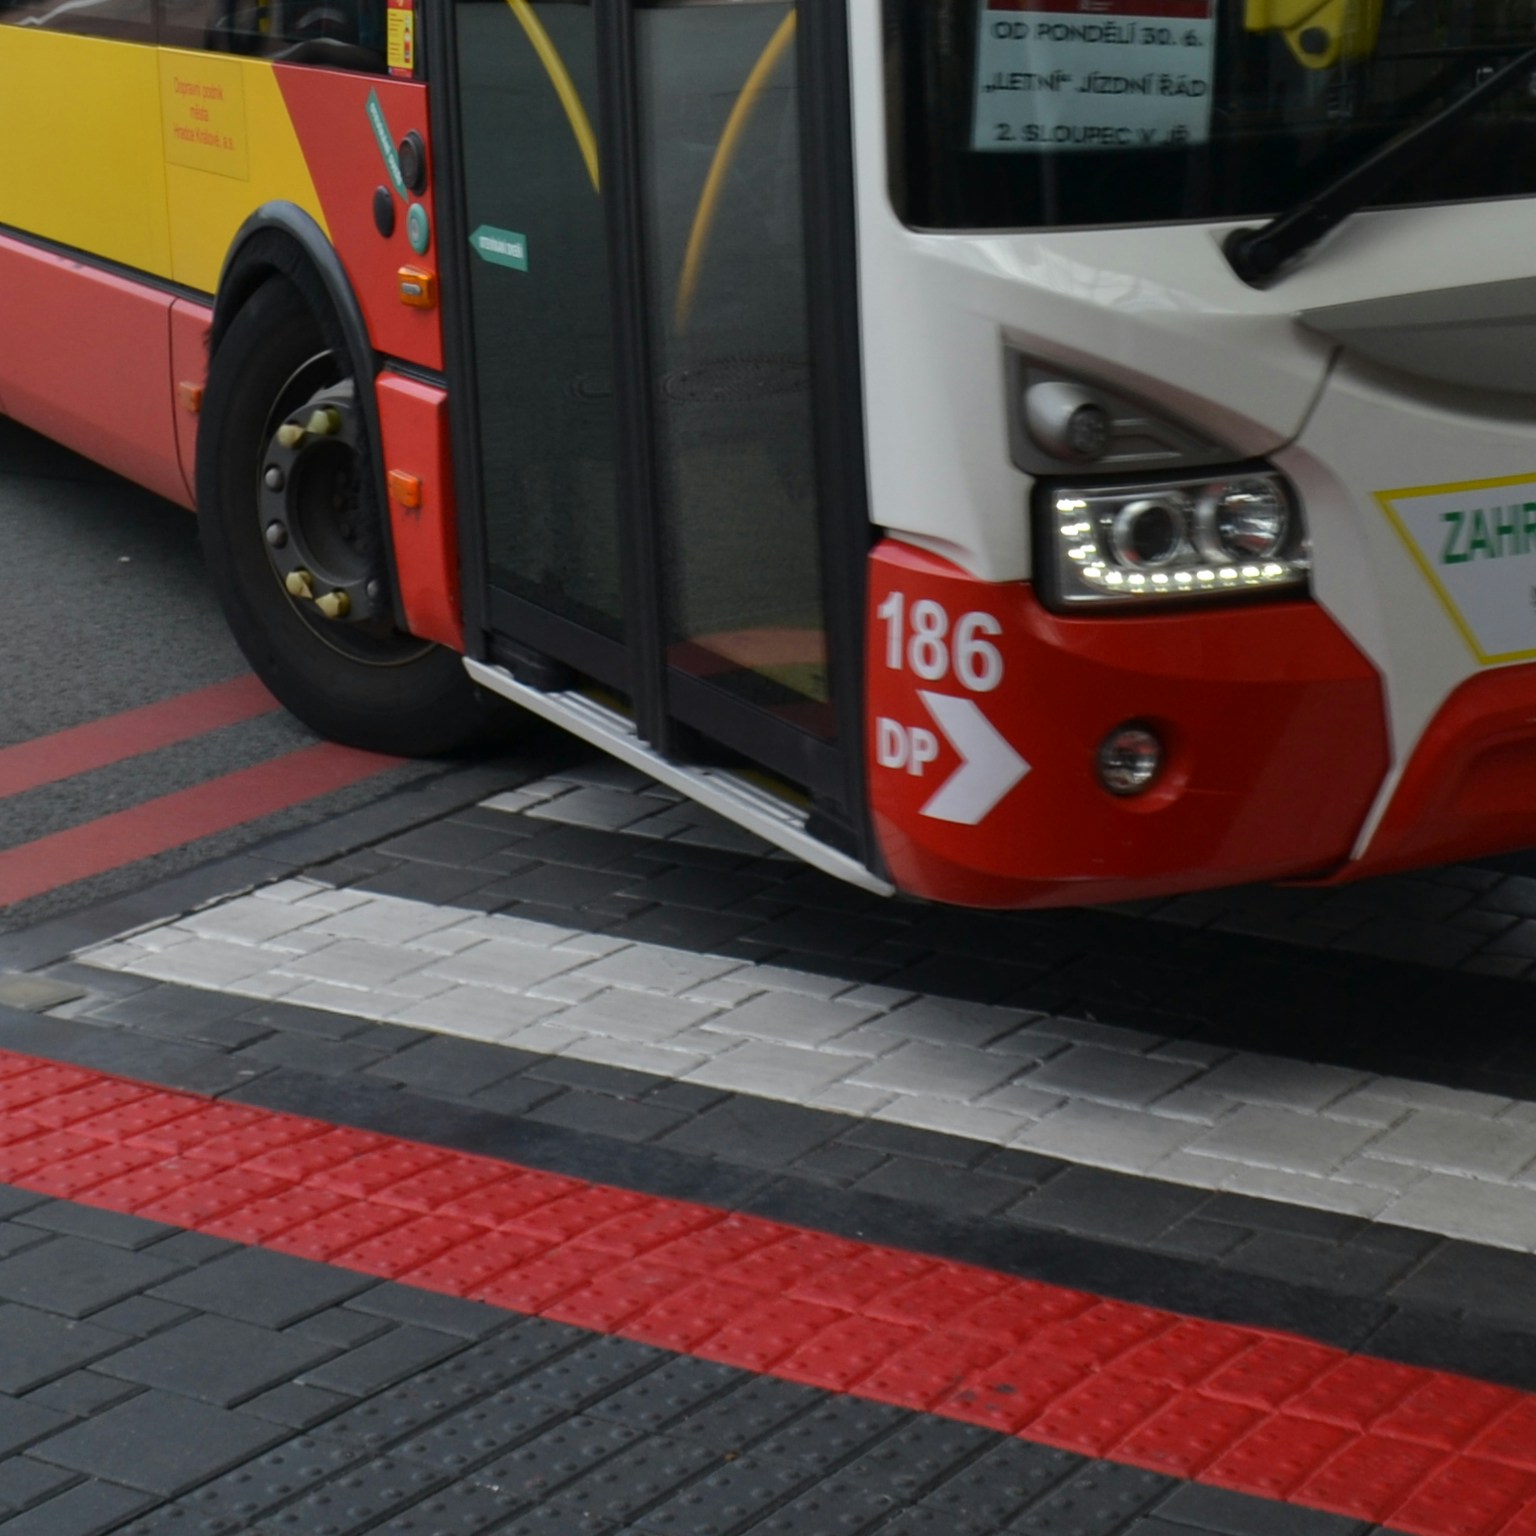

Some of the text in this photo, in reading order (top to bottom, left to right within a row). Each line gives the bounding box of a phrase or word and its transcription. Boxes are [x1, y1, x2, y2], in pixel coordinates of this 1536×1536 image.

[993, 20, 1029, 41] OD
[1037, 19, 1137, 44] PONDĚLÍ
[1078, 70, 1154, 96] JÍZDNÍ
[1160, 73, 1207, 98] ŘÁD
[1021, 122, 1132, 145] SLOUPEC
[876, 591, 1004, 693] 186
[875, 716, 940, 777] DP
